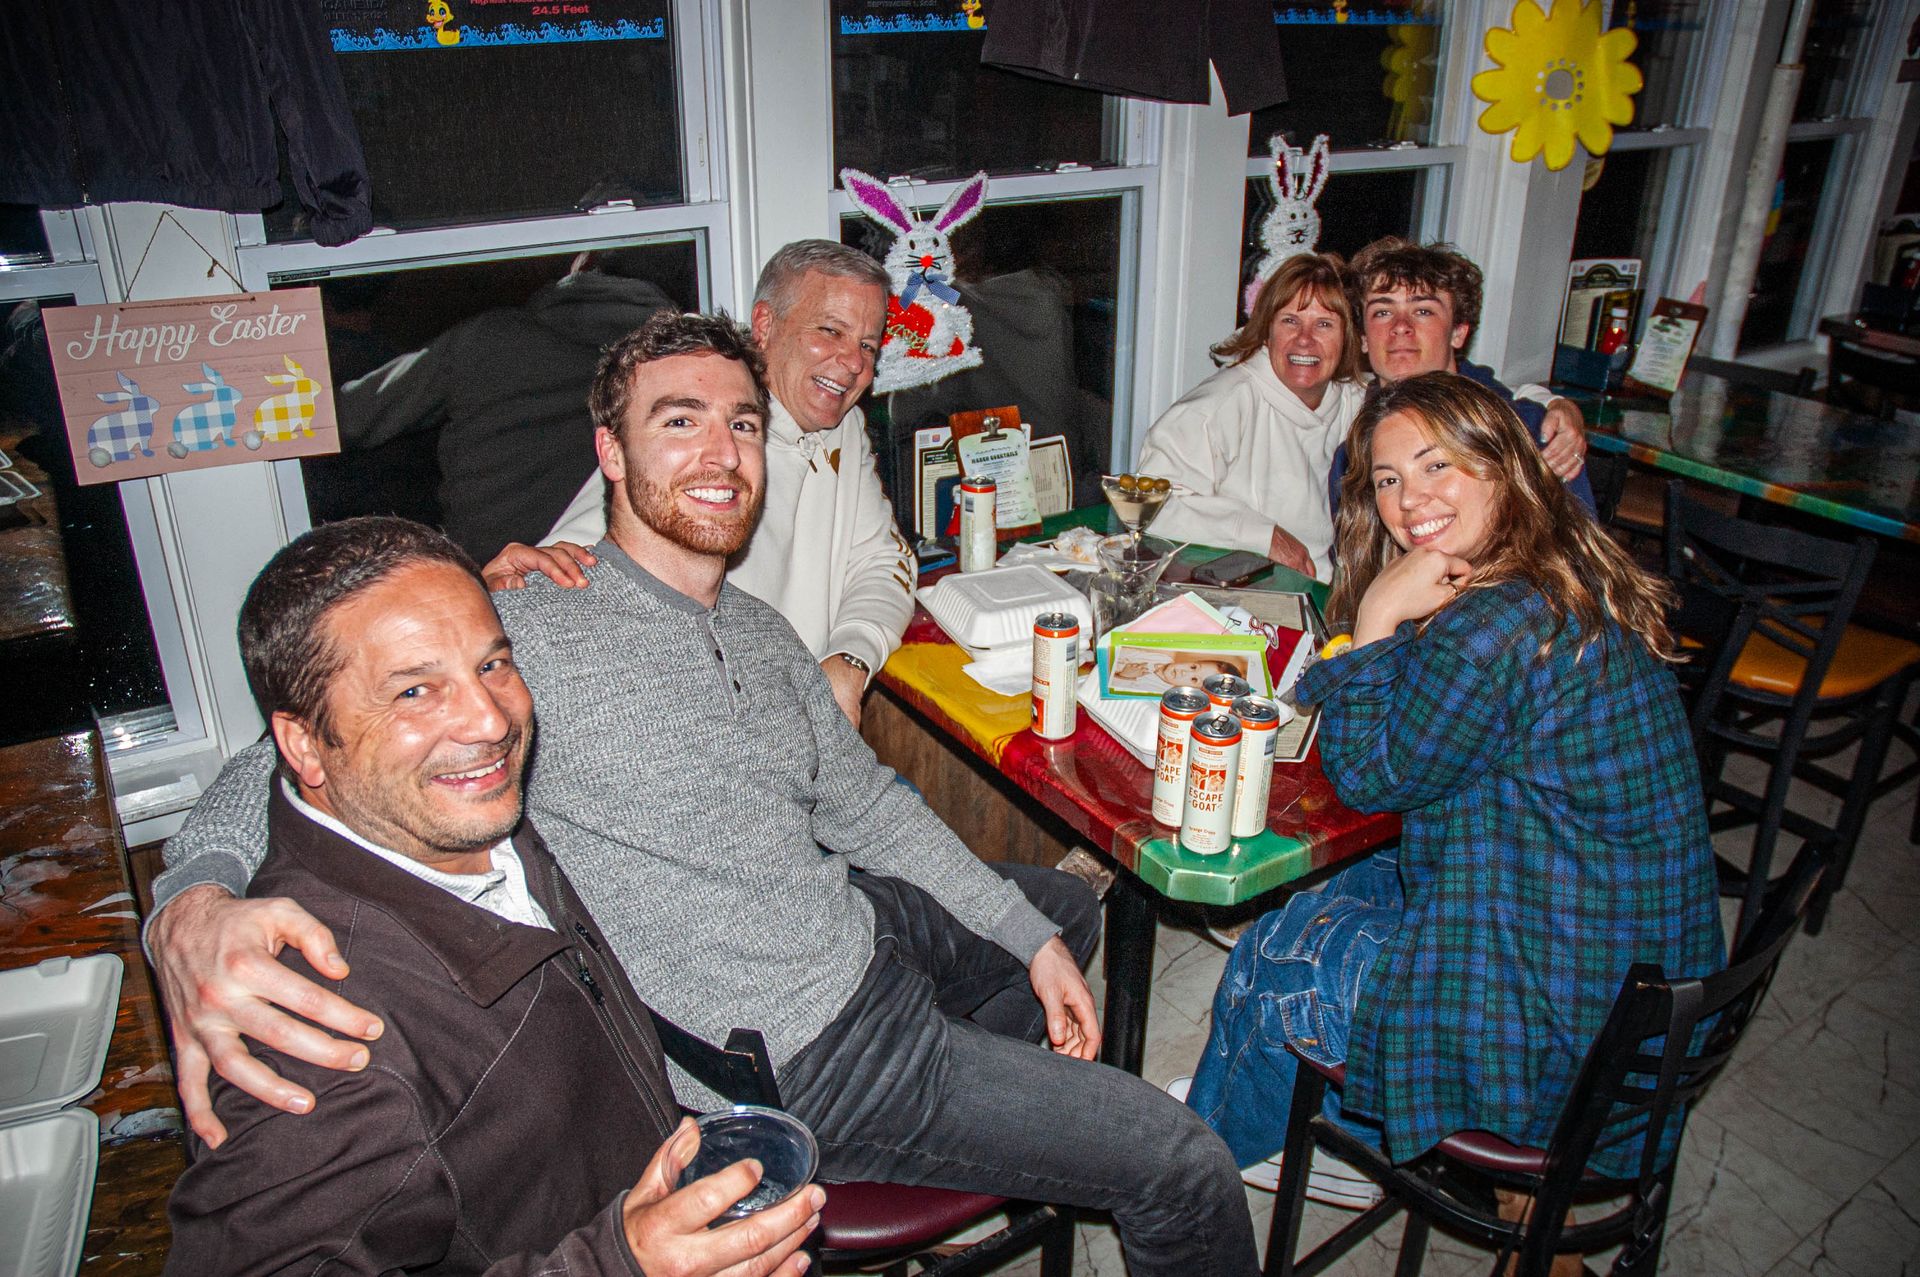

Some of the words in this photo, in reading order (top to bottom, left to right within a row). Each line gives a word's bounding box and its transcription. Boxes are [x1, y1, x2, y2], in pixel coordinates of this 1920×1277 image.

[532, 6, 560, 15] 24.5
[562, 4, 590, 14] Feet
[67, 314, 199, 364] Happy
[208, 304, 306, 347] Easter
[1188, 786, 1223, 802] ESCAPE
[1192, 799, 1217, 812] GOAT
